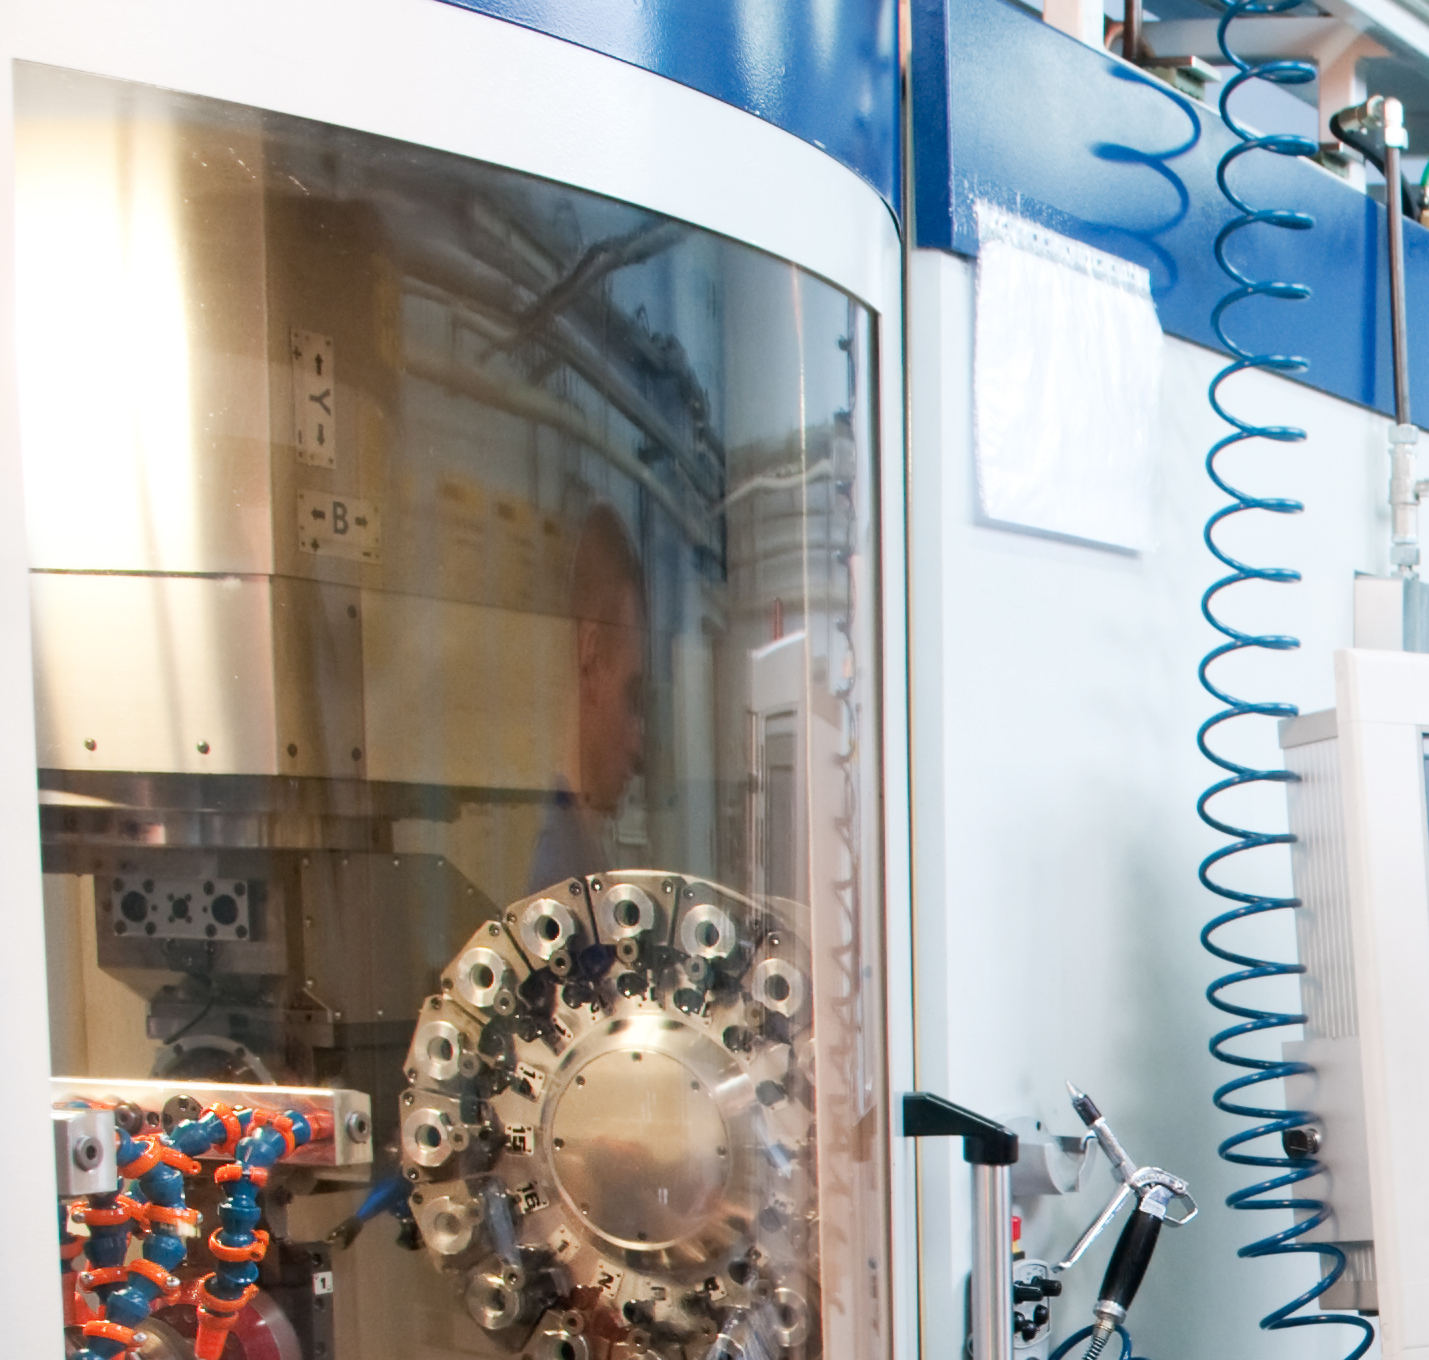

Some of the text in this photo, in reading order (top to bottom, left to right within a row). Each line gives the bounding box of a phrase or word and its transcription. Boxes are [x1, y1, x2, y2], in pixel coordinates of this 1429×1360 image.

[308, 388, 331, 416] Y
[332, 501, 349, 535] B
[511, 1125, 526, 1154] 15
[521, 1180, 541, 1213] 16
[320, 1277, 326, 1289] 1
